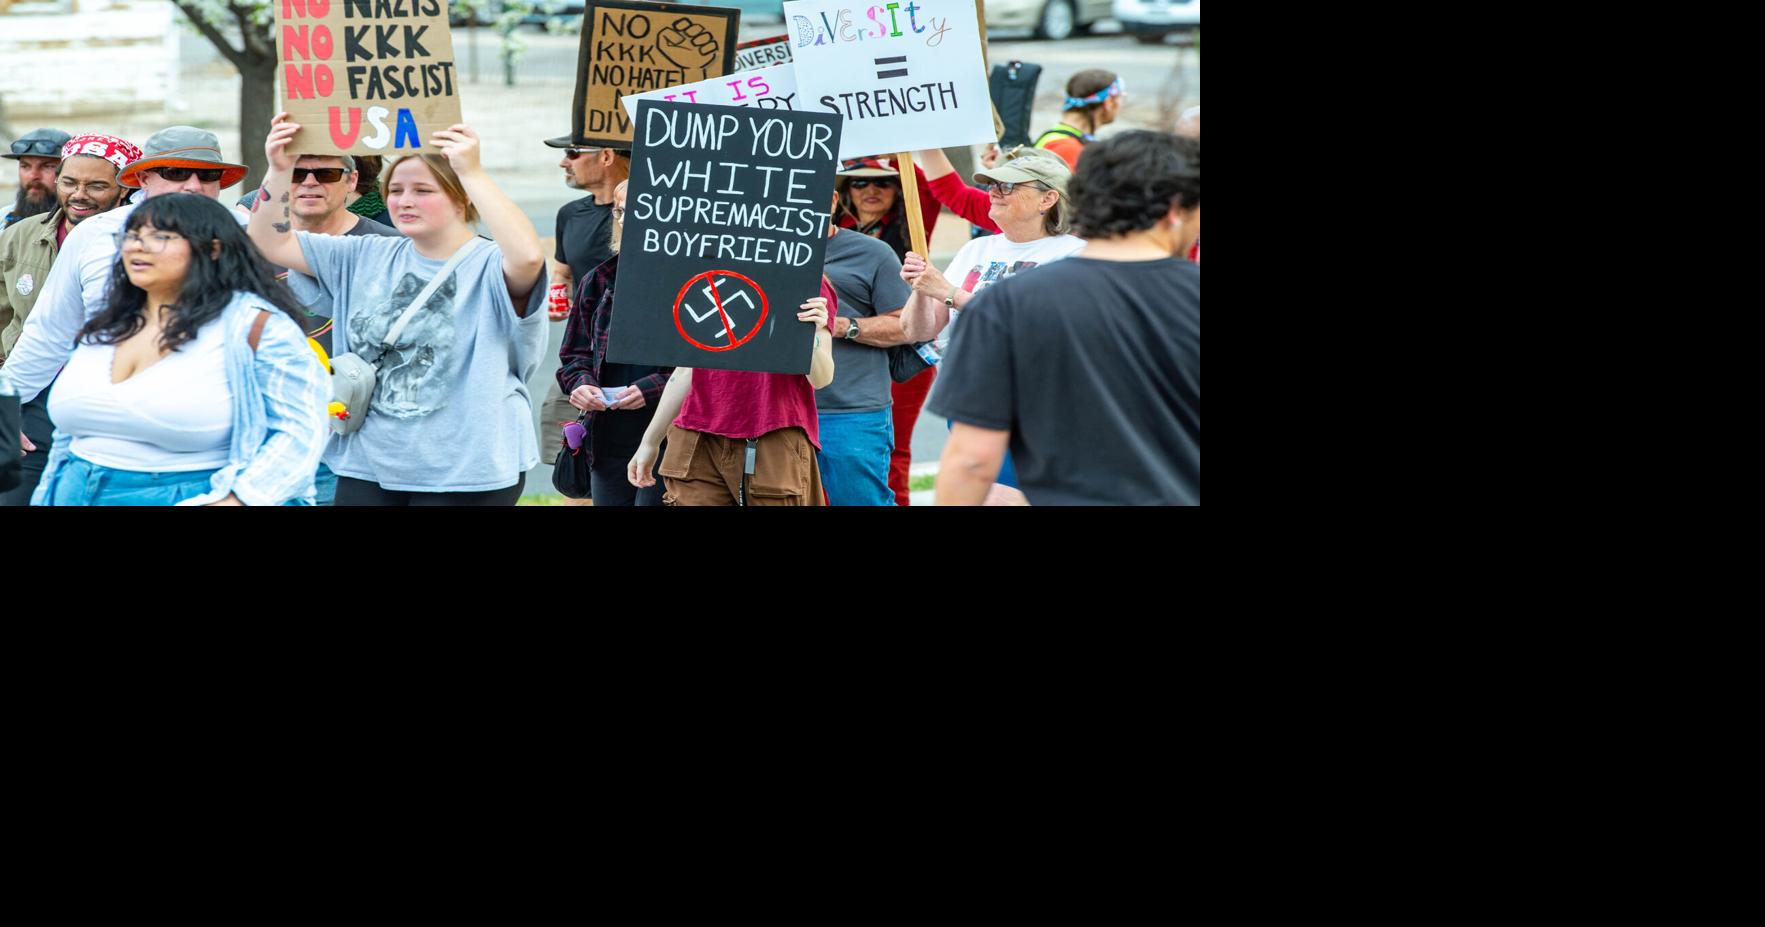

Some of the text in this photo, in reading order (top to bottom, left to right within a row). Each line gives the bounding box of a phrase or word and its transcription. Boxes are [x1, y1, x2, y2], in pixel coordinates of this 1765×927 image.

[282, 24, 431, 63] NO KKK
[601, 12, 651, 39] NO
[596, 41, 656, 66] KKK
[284, 61, 454, 100] NO FASCIST
[592, 64, 681, 89] NO HATE
[726, 76, 770, 101] IS
[820, 81, 958, 121] STRENGTH
[327, 106, 422, 150] USA
[645, 107, 833, 161] DUMP YOUR
[646, 157, 816, 204] WHITE
[634, 193, 831, 239] SUPREMACIST
[643, 228, 813, 266] BOYFRIEND
